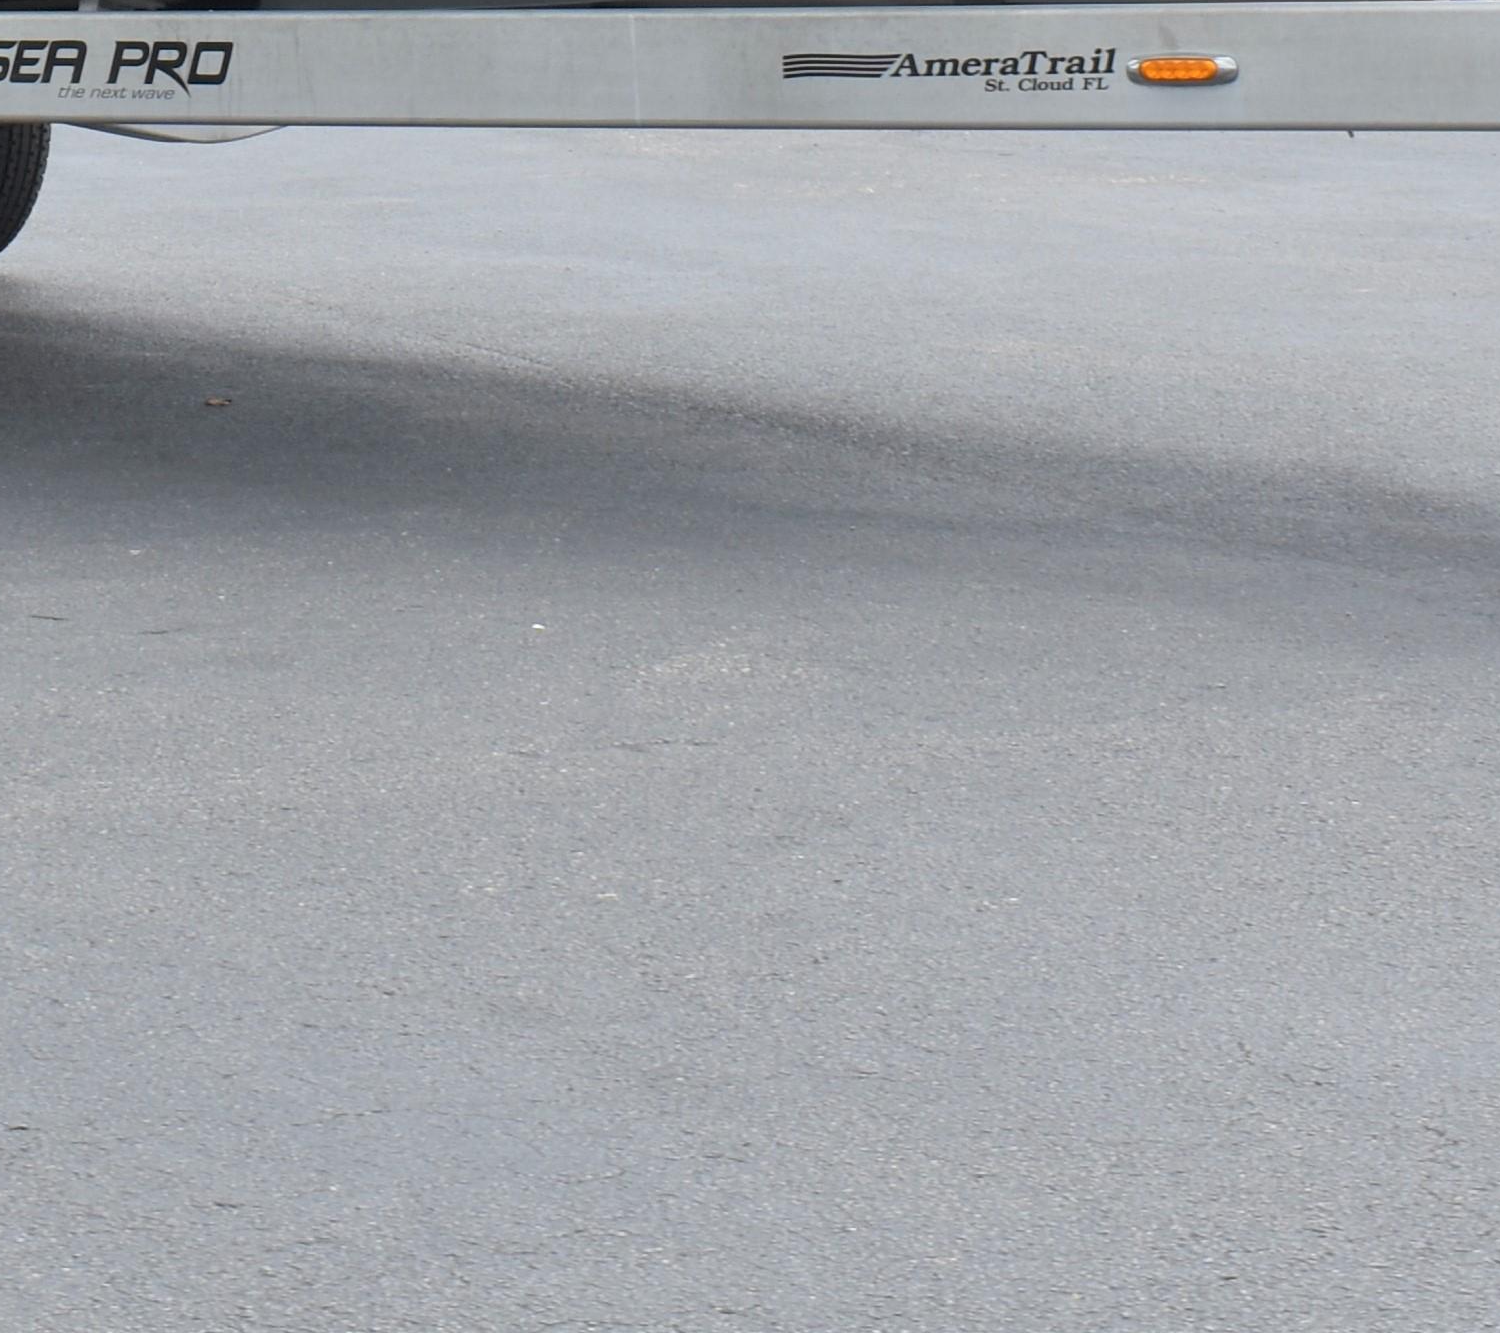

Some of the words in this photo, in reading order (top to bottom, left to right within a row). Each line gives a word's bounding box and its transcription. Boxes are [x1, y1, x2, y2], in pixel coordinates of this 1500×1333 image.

[106, 41, 235, 98] PRO
[890, 48, 1117, 78] AmeraTrail
[56, 86, 85, 99] the
[89, 87, 127, 100] next
[131, 88, 176, 100] wave
[984, 79, 1011, 93] St.
[1017, 78, 1075, 92] Cloud
[1081, 77, 1110, 91] FL
